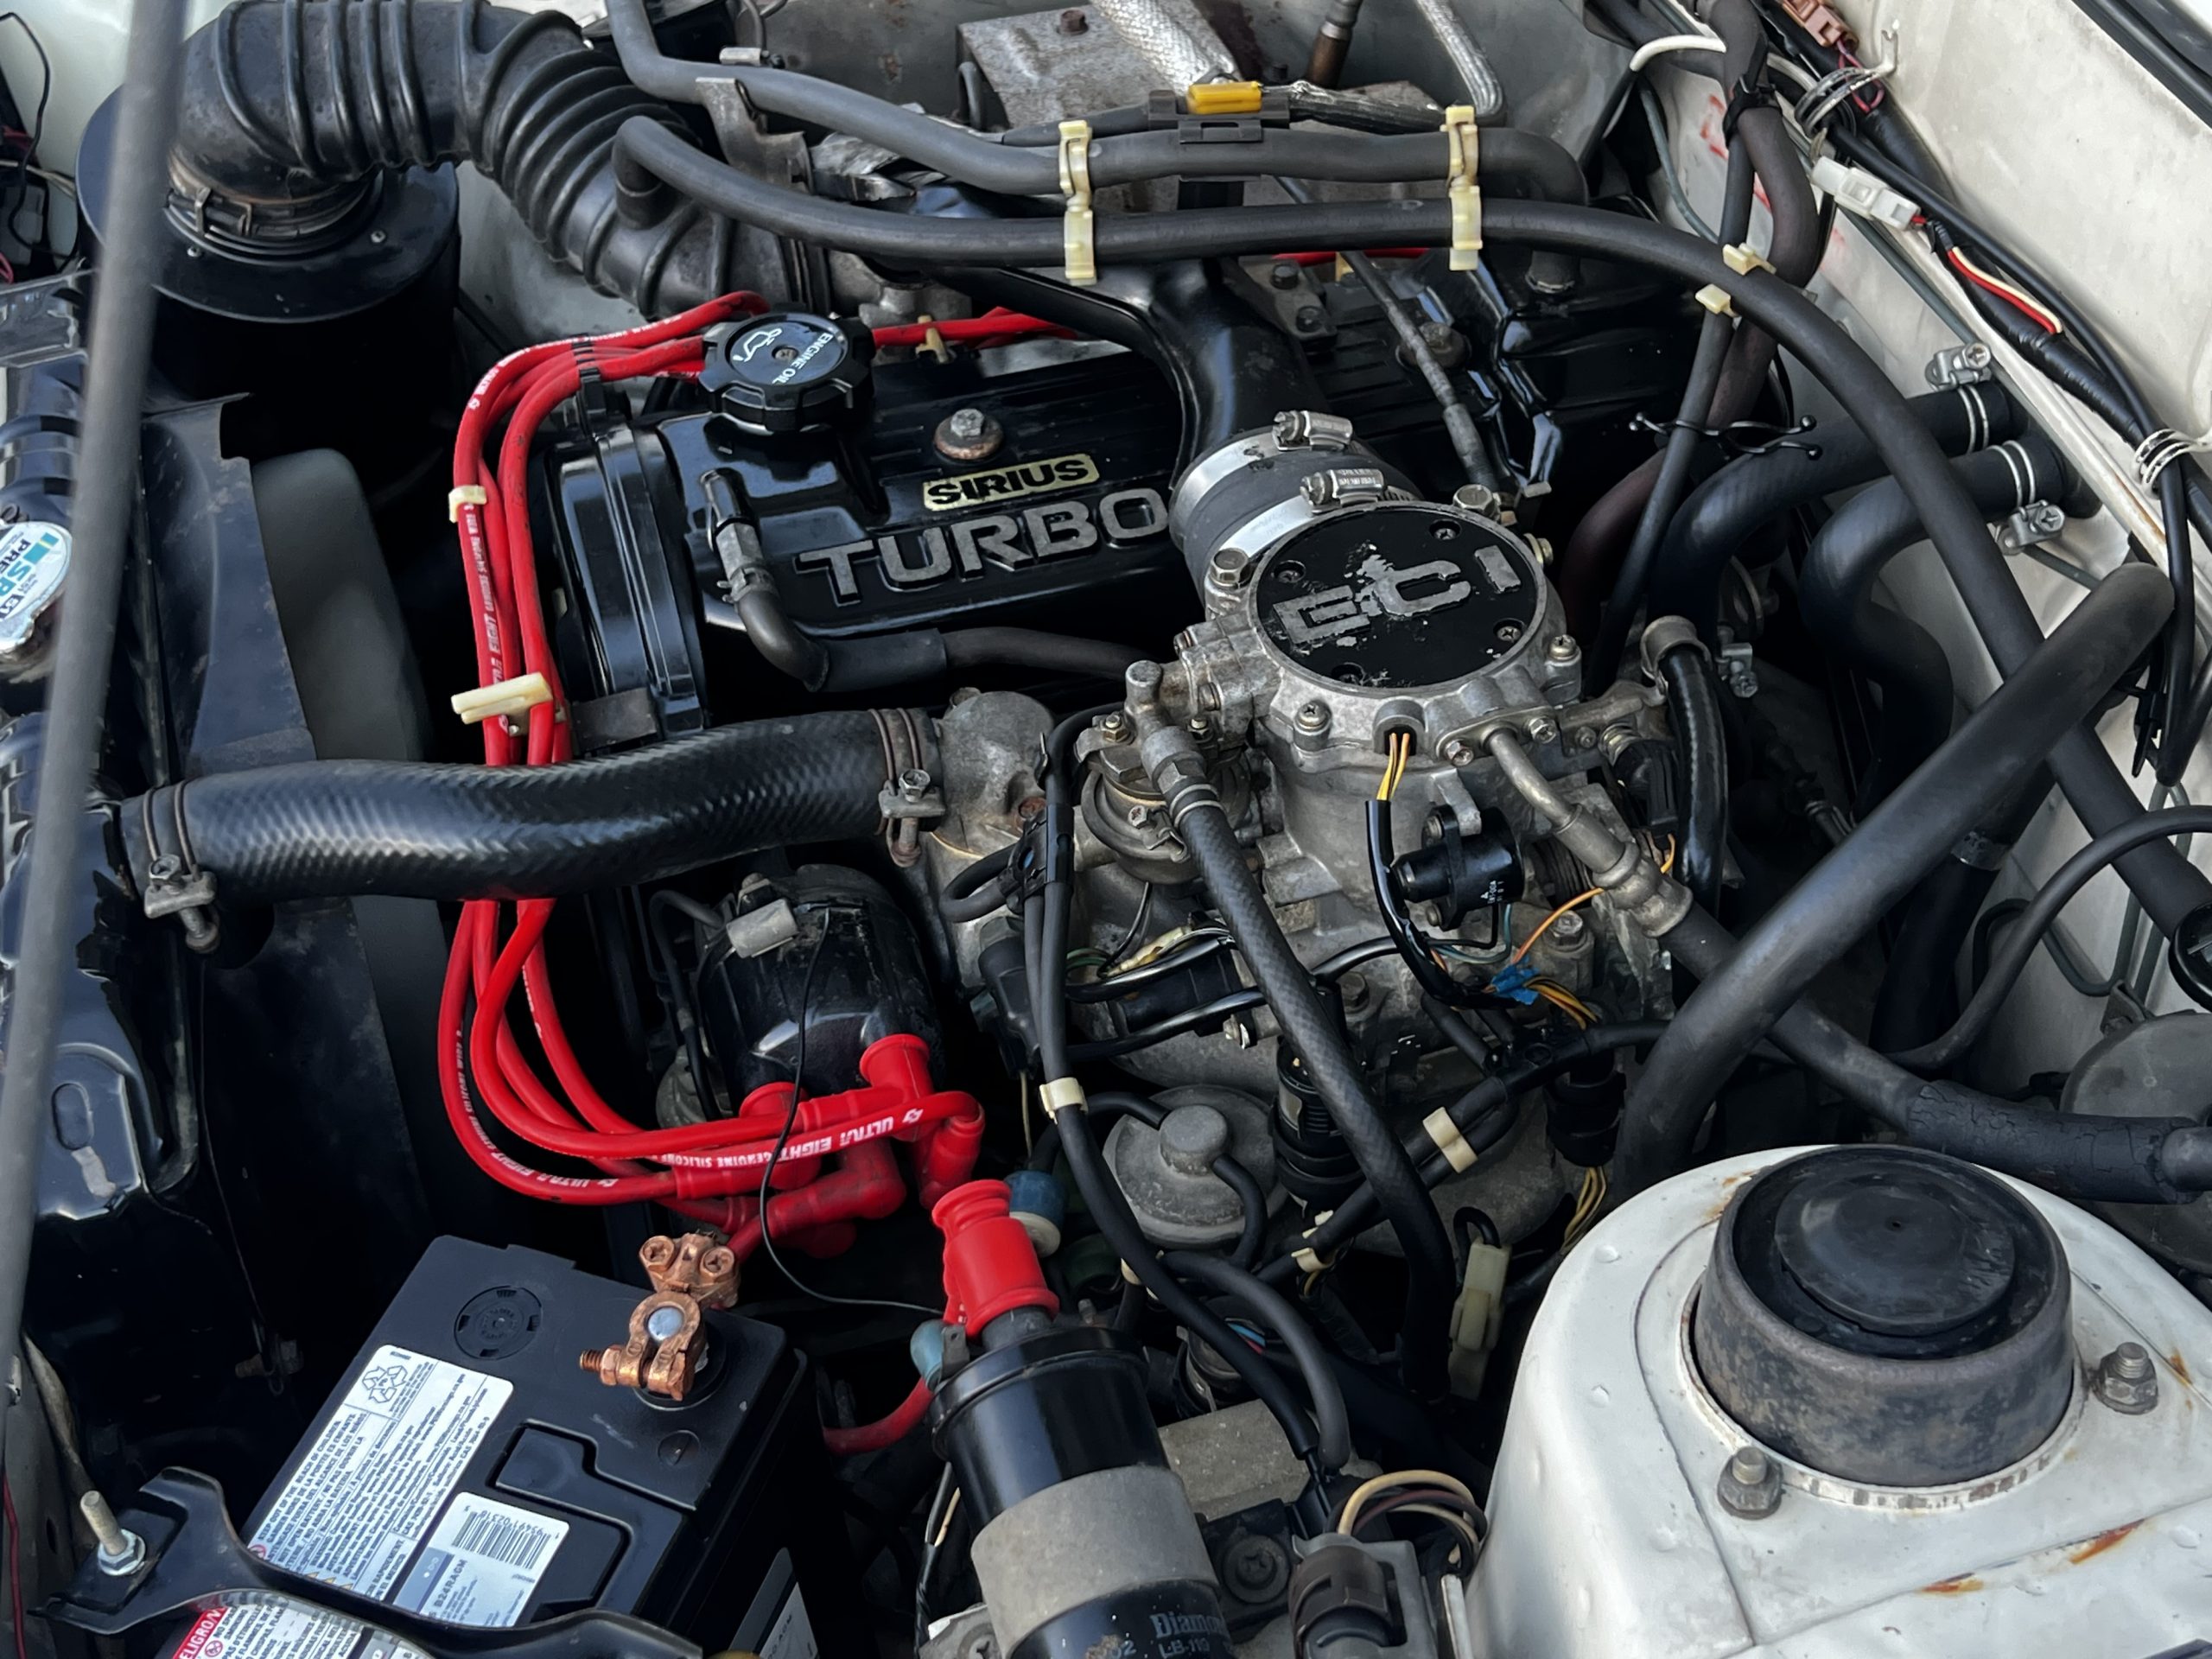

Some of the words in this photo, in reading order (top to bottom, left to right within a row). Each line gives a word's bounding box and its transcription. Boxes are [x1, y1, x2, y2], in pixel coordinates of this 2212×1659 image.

[791, 332, 834, 370] ENGINE
[772, 368, 796, 385] OIL
[927, 459, 1090, 505] SIRIUS
[797, 487, 1169, 605] TURBO
[1272, 544, 1522, 646] ECI
[840, 1116, 893, 1147] ULTRA
[716, 1150, 771, 1168] GENUINE
[776, 1136, 832, 1162] EIGHT
[178, 1607, 226, 1659] ELIGRO/V
[1149, 1611, 1226, 1639] Diamo
